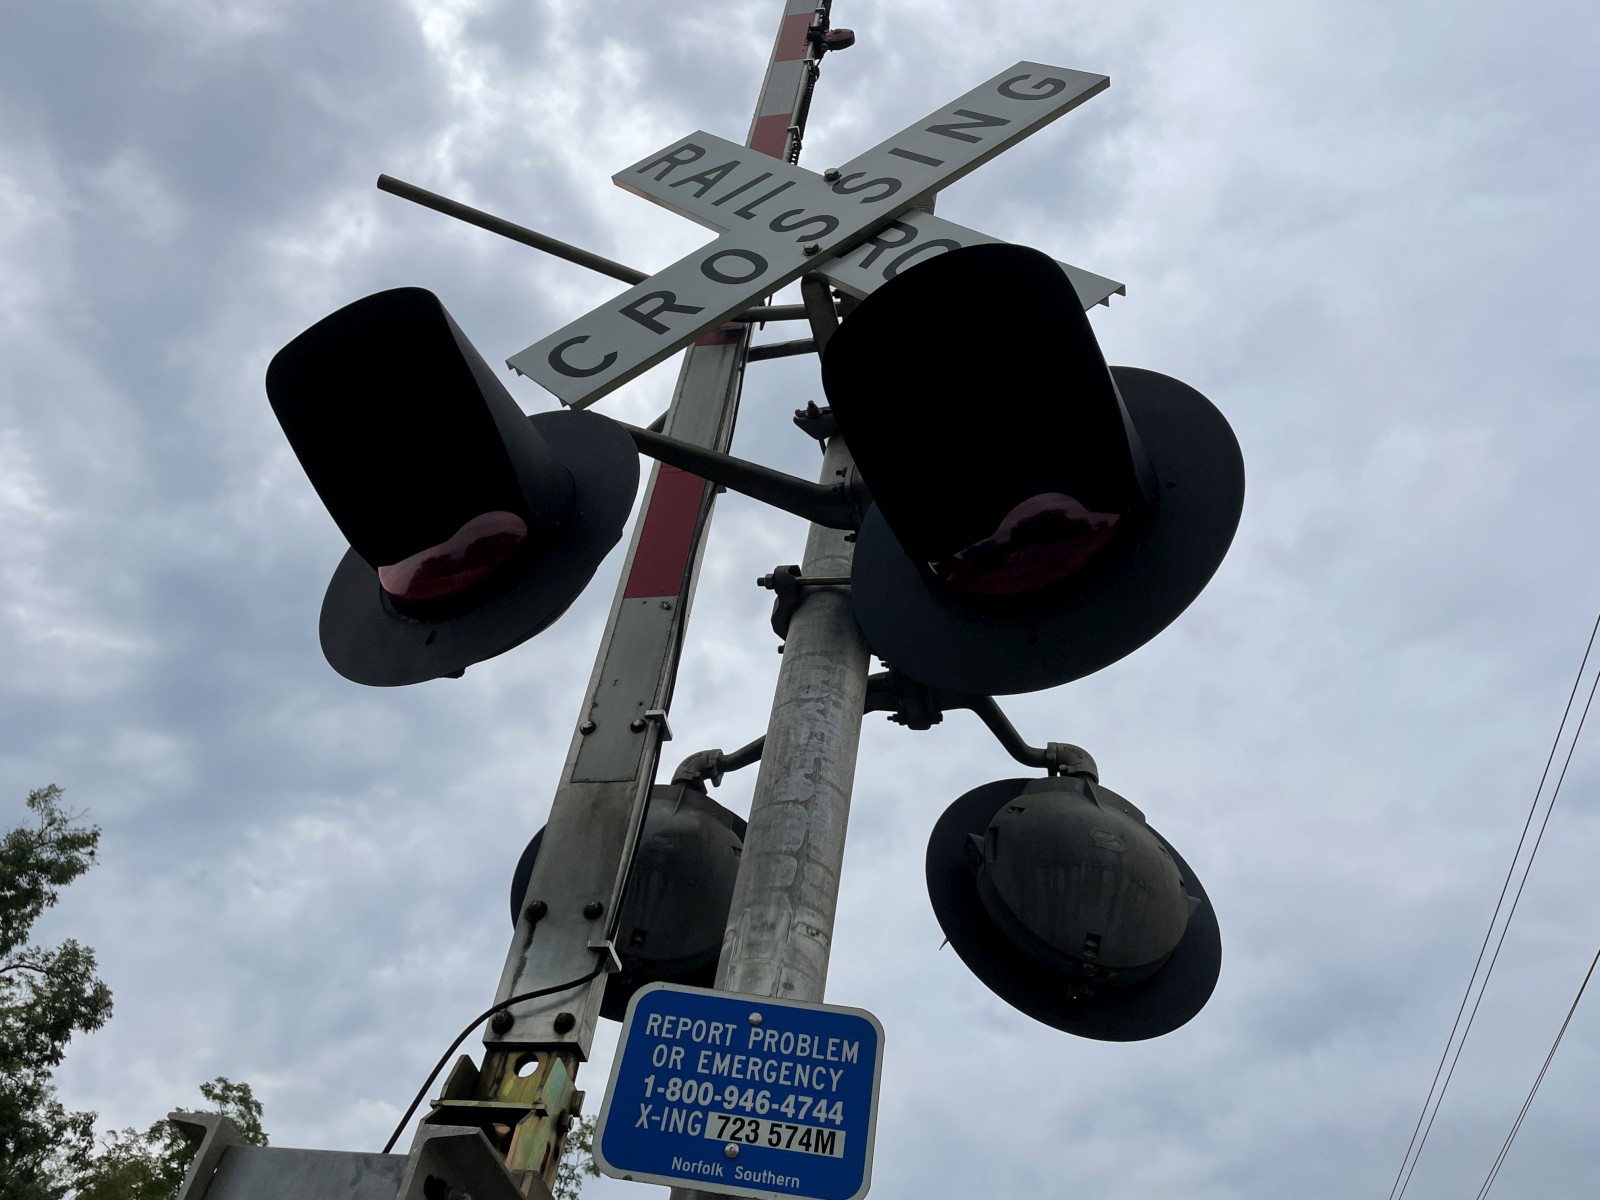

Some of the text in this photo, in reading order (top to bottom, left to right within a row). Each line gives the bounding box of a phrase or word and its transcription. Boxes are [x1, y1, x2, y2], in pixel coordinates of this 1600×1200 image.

[547, 73, 1067, 378] CROSSING
[636, 143, 962, 281] RAIL RO
[646, 1013, 859, 1064] REPORT PROBLEM
[652, 1044, 843, 1092] OR EMERGENCY
[644, 1075, 843, 1125] 1-800-946-4744
[635, 1103, 836, 1155] X-ING 723 574M
[671, 1156, 800, 1188] Norfolk Southern
